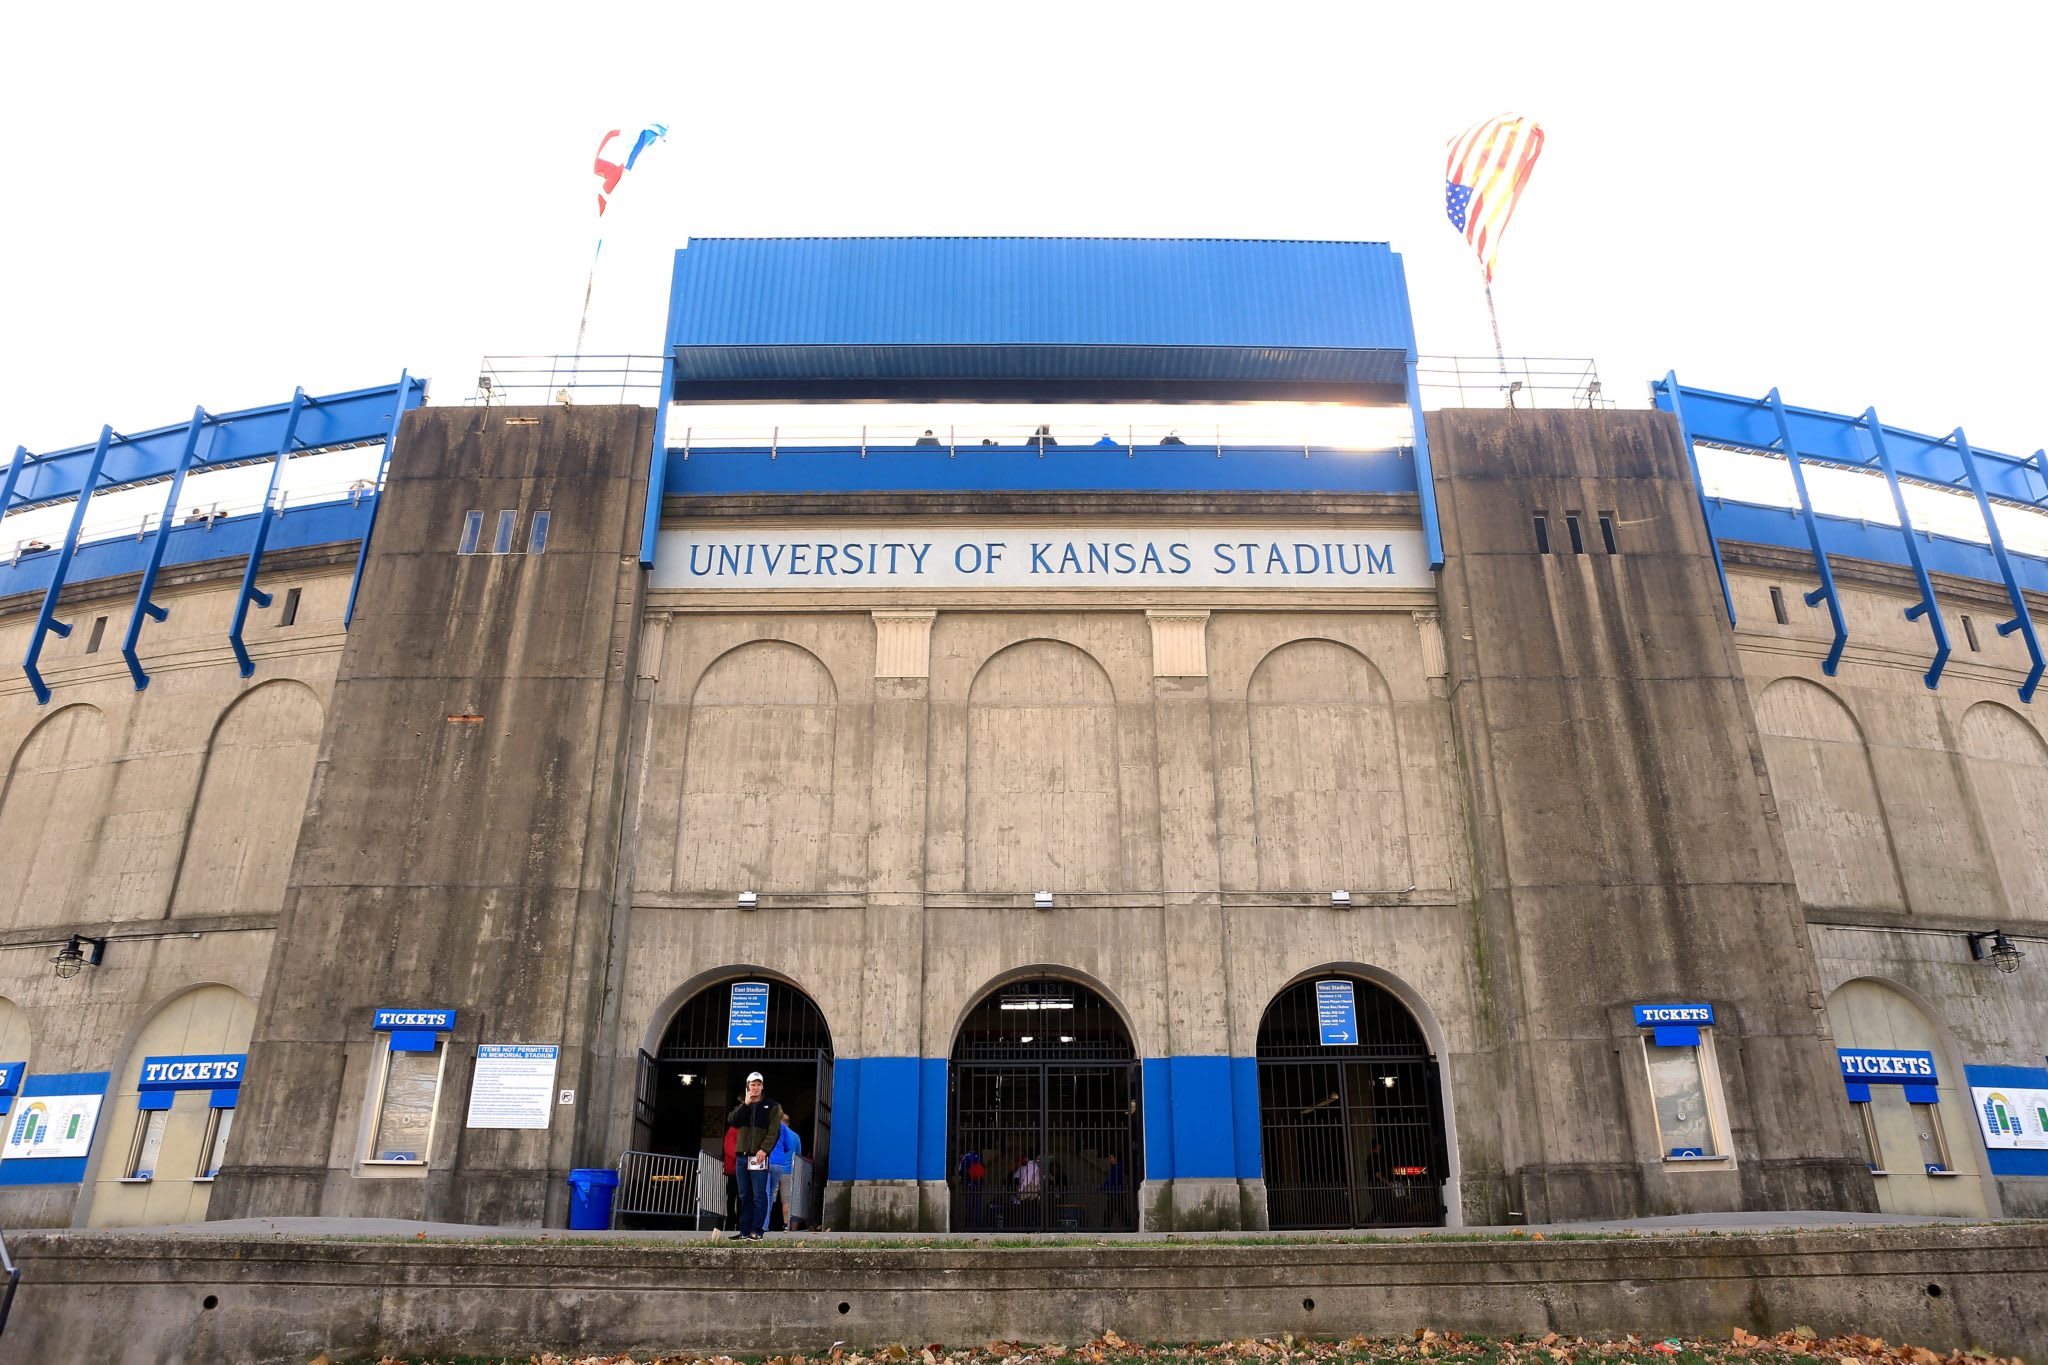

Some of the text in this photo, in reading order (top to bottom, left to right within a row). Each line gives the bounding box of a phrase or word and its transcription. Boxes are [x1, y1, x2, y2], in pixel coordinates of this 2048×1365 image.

[689, 542, 1397, 576] UNIVERSITY OF KANSAS STADIUM
[380, 1013, 447, 1025] TICKETS
[1642, 1008, 1709, 1020] TICKETS
[146, 1061, 240, 1081] TICKETS
[1841, 1056, 1932, 1075] TICKETS
